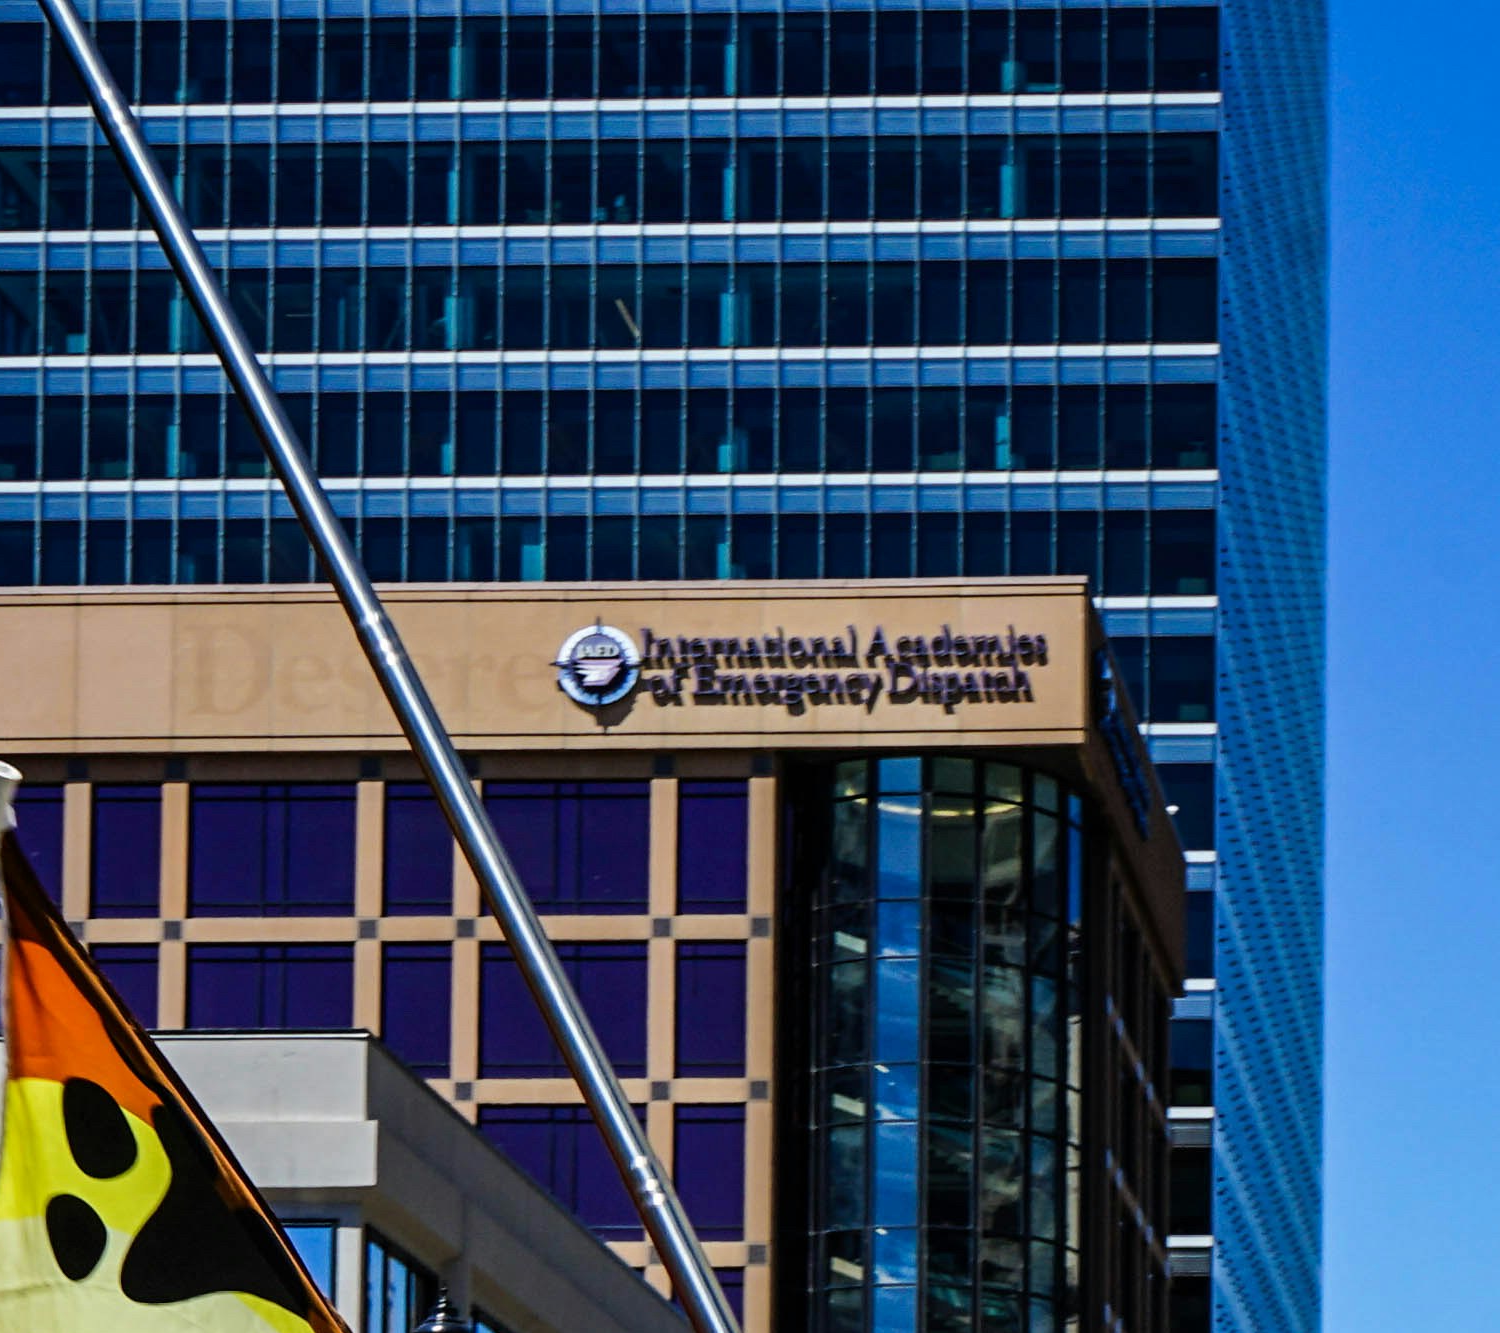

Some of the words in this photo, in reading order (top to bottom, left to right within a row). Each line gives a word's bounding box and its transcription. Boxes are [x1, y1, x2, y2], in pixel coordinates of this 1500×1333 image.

[640, 624, 857, 664] International
[866, 623, 1049, 662] Academies
[650, 662, 691, 703] of
[694, 662, 884, 715] Emergency
[886, 658, 1036, 714] Dispatch
